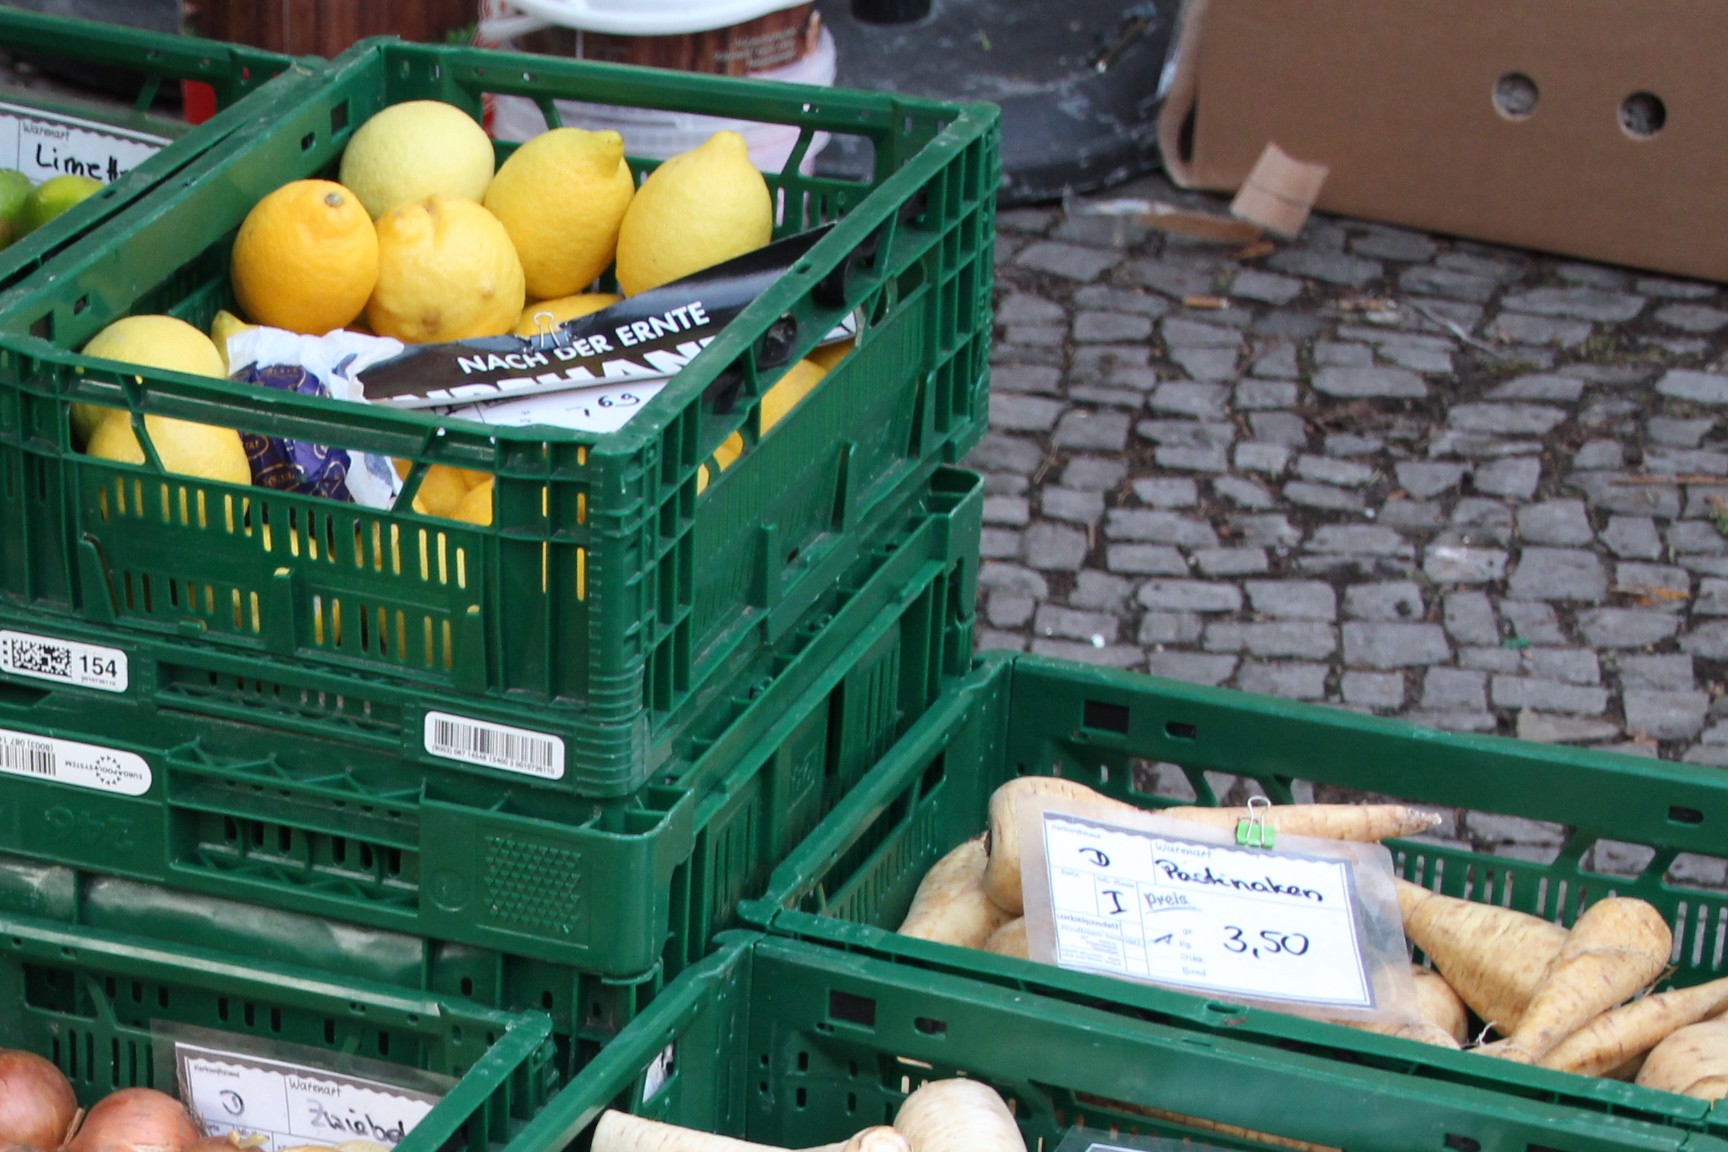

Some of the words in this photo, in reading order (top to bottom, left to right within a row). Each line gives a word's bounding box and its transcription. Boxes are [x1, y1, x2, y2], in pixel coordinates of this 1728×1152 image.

[23, 121, 71, 142] Warenart
[456, 345, 550, 375] NACH
[552, 335, 614, 362] DER
[614, 301, 711, 348] ERNTE
[79, 654, 118, 679] 154
[64, 759, 93, 771] SYSTEM
[1078, 847, 1111, 868] D
[1155, 859, 1324, 903] Pastinaken
[1223, 925, 1310, 959] 3,50
[288, 1077, 342, 1098] Warenart
